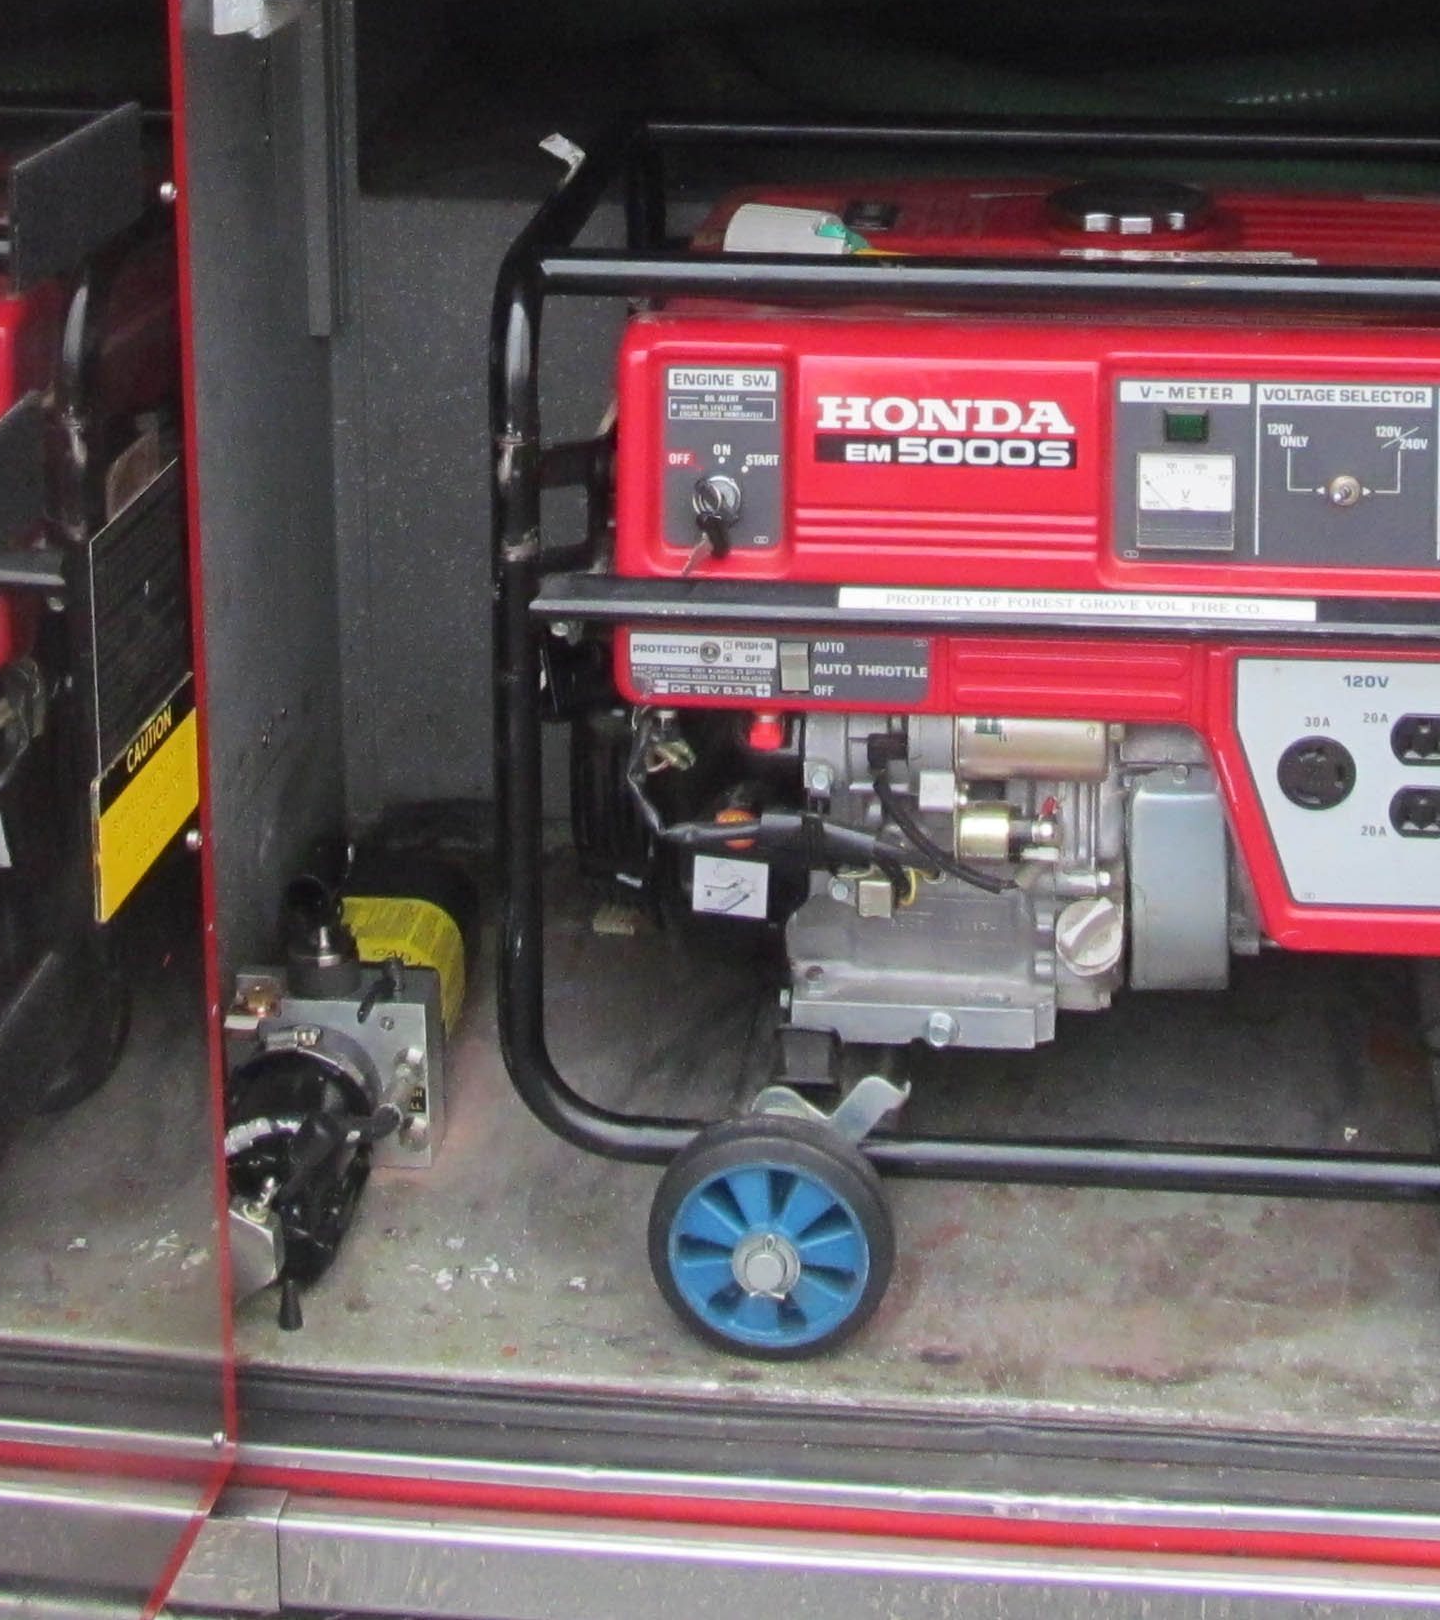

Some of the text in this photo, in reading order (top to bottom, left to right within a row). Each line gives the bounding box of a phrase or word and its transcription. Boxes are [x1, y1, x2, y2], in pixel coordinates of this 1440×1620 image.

[673, 373, 734, 386] ENGINE
[1263, 388, 1426, 403] VOLTAGE SELECTOR
[816, 396, 1075, 434] HONDA
[1267, 423, 1293, 435] 120V
[1280, 436, 1309, 447] ONLY
[1399, 438, 1428, 450] 240V
[713, 444, 731, 455] ON
[668, 452, 690, 465] OFF
[745, 454, 780, 466] START
[886, 593, 974, 607] PROPERTY
[979, 595, 1000, 607] OF
[1008, 596, 1073, 608] FOREST
[1080, 597, 1137, 610] GROVE
[1191, 602, 1232, 613] FIRE
[632, 644, 699, 654] PROTECTOR
[813, 642, 844, 654] AUTO
[814, 664, 928, 678] AUTO THROTTLE
[1343, 675, 1389, 688] 120V
[670, 683, 690, 693] DC
[813, 685, 834, 696] OFF
[1304, 716, 1330, 728] 30A
[1363, 713, 1388, 724] 20A
[126, 705, 172, 773] CAUTION
[1361, 826, 1387, 837] 20A
